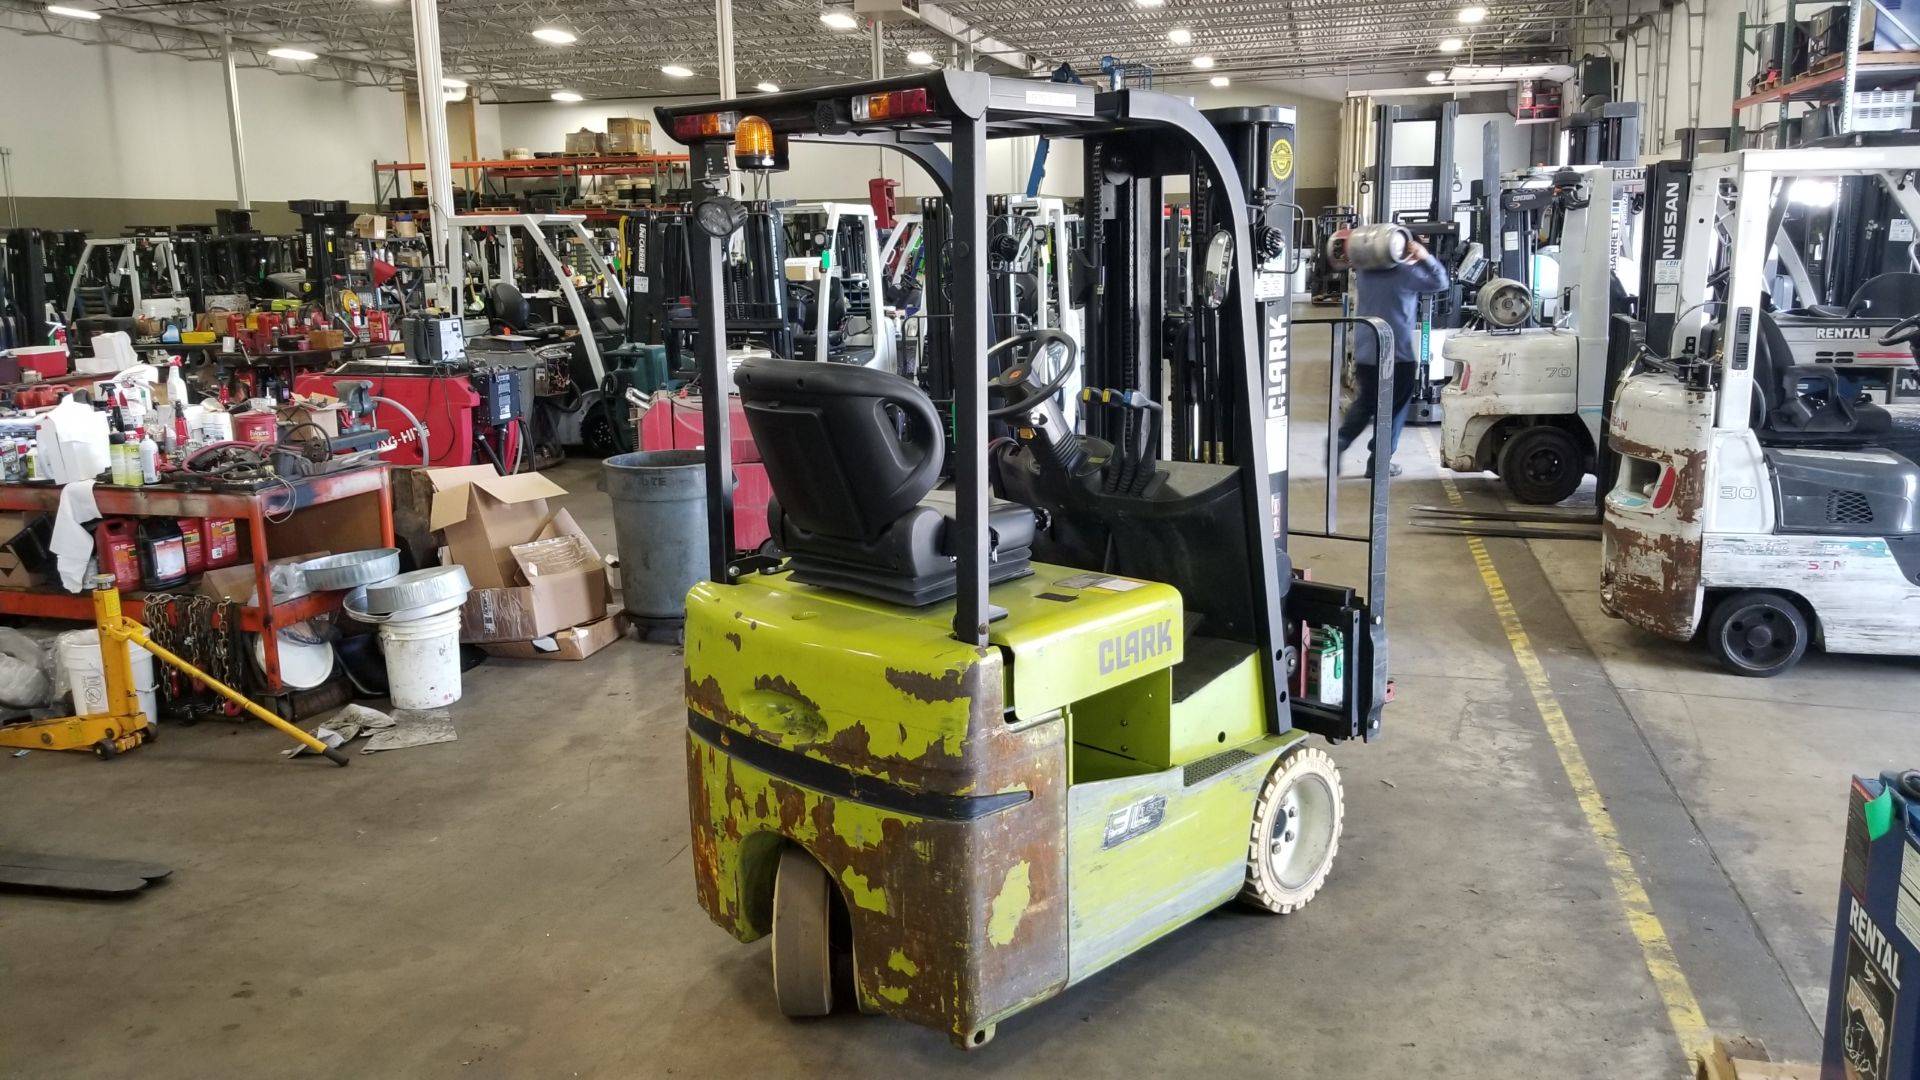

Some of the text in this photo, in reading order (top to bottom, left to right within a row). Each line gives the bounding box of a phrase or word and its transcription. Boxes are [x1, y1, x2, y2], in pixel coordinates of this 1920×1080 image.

[1662, 182, 1680, 259] NISSAN
[305, 233, 313, 257] CLARK
[1816, 328, 1870, 339] RENTAL
[1267, 313, 1288, 418] CLARK
[1544, 367, 1572, 378] 70
[1719, 486, 1757, 500] 30
[1099, 619, 1172, 675] CLARK
[1850, 896, 1900, 990] RENTAL
